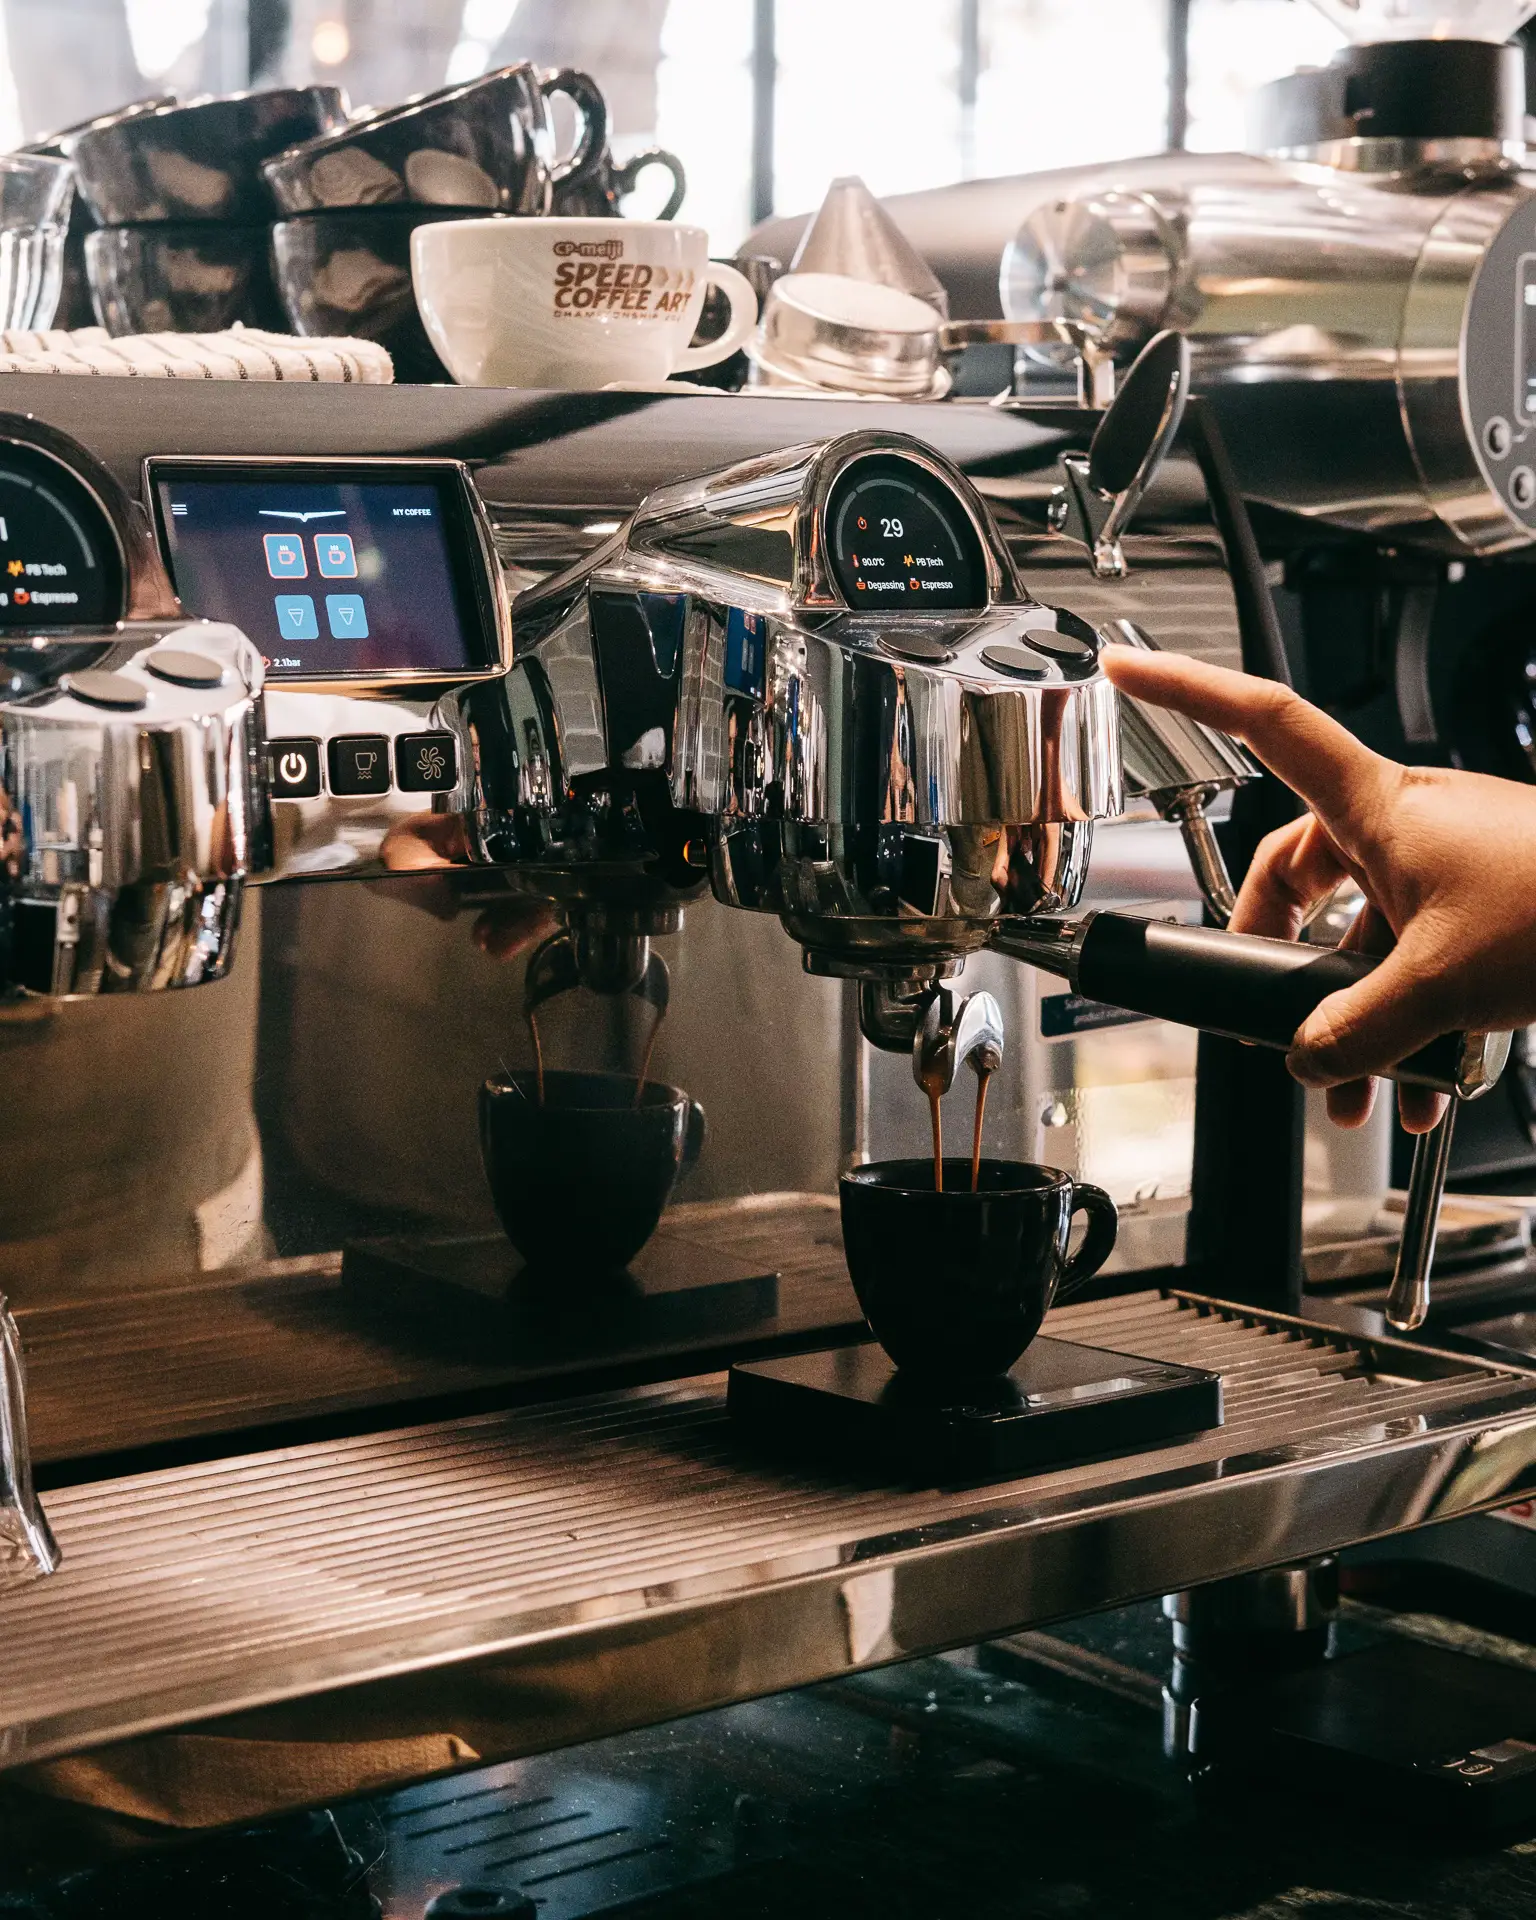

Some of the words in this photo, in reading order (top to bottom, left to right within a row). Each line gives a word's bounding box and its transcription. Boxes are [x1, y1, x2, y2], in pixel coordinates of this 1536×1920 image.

[554, 262, 653, 288] SPEED
[554, 287, 652, 310] COFFEE
[654, 291, 692, 312] ART
[392, 508, 404, 516] MY
[404, 508, 432, 516] COFFEE
[880, 518, 904, 538] 29
[916, 557, 926, 567] PB
[926, 557, 944, 567] Tech
[867, 580, 906, 592] Degassing
[921, 580, 954, 591] Espresso
[273, 657, 301, 667] 2.1bar
